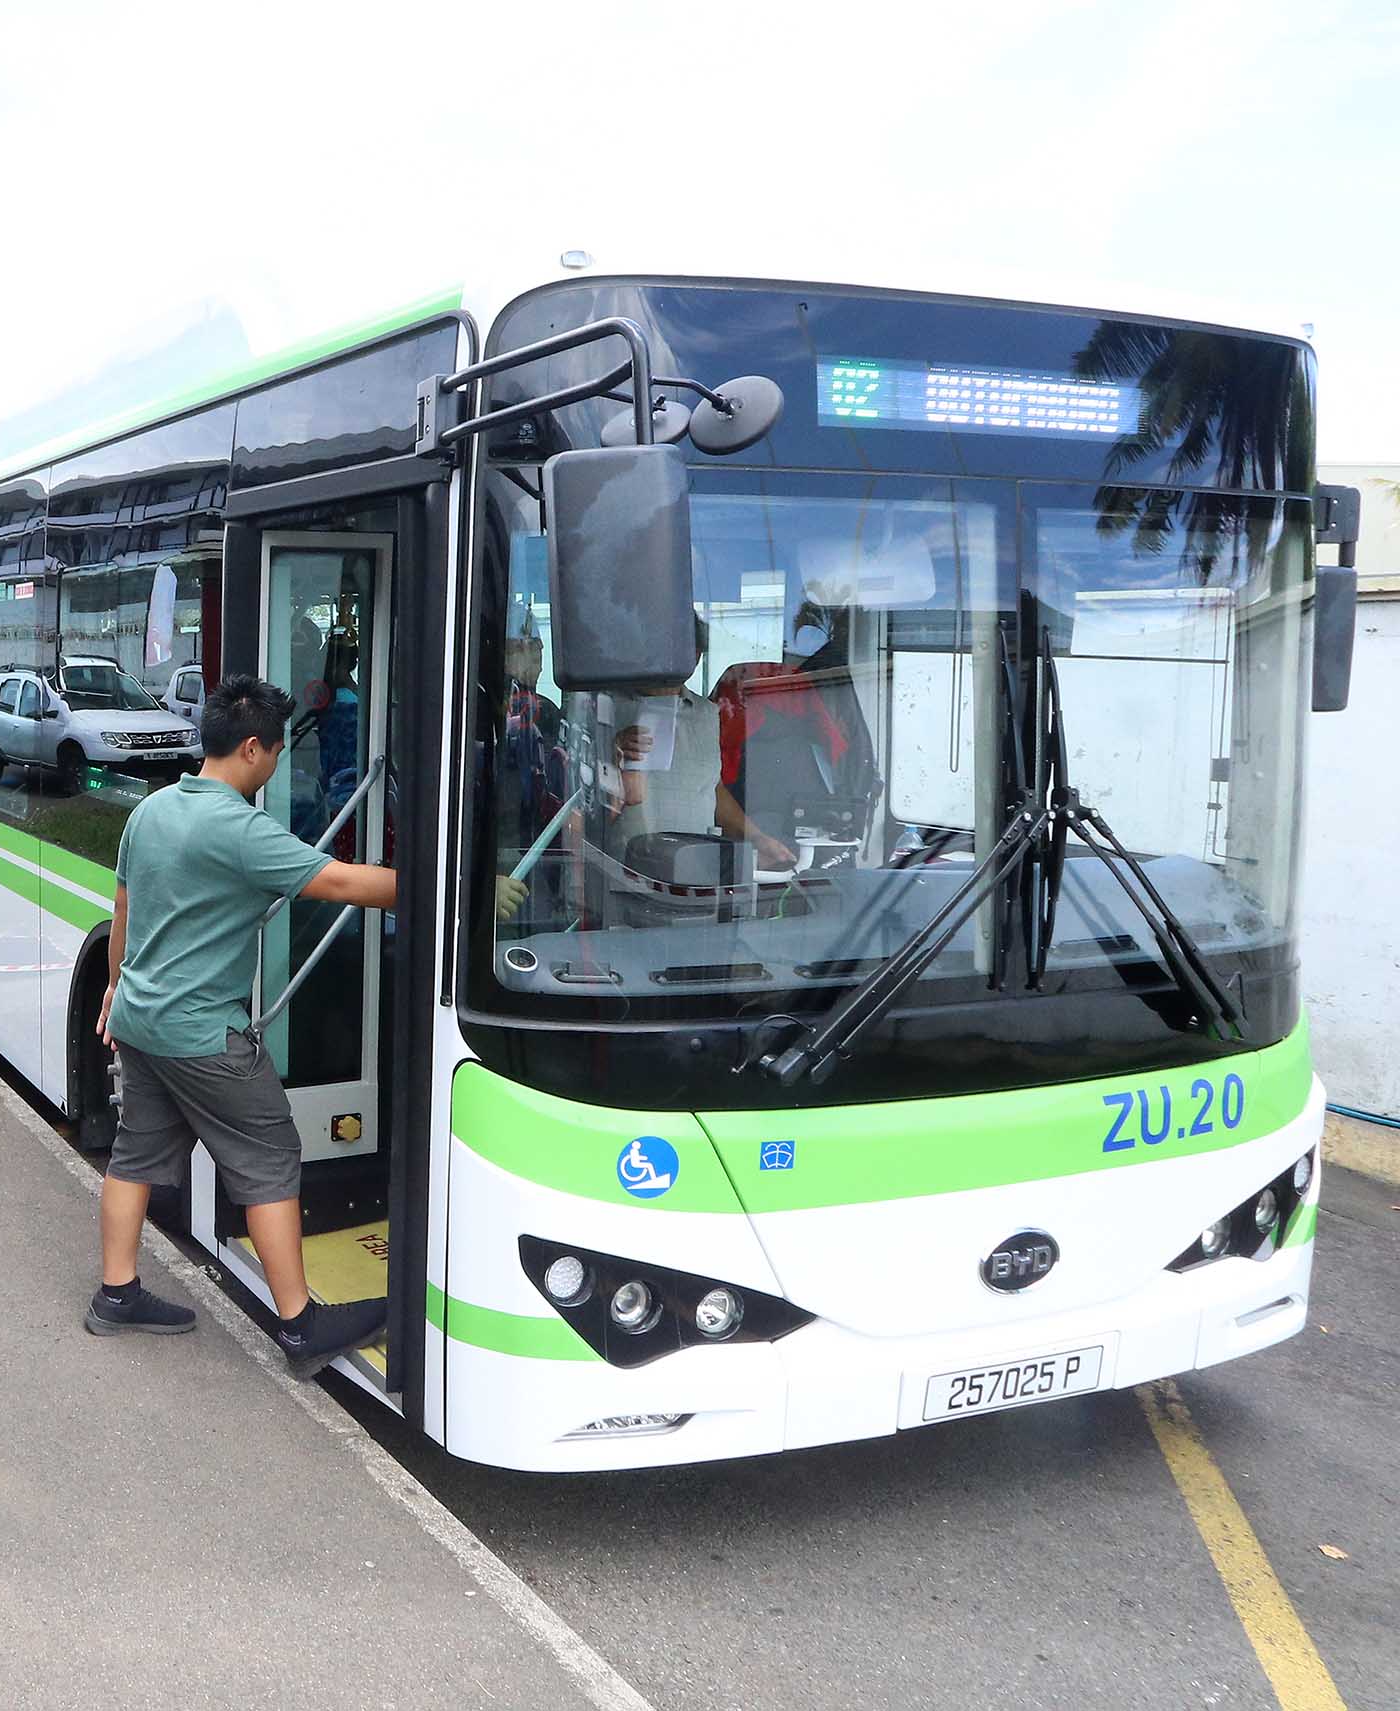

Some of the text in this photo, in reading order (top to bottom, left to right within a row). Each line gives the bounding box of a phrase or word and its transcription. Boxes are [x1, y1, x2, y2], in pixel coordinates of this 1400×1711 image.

[1102, 1073, 1244, 1152] ZU.20
[991, 1245, 1052, 1279] BYD
[947, 1356, 1081, 1410] 257025 P
